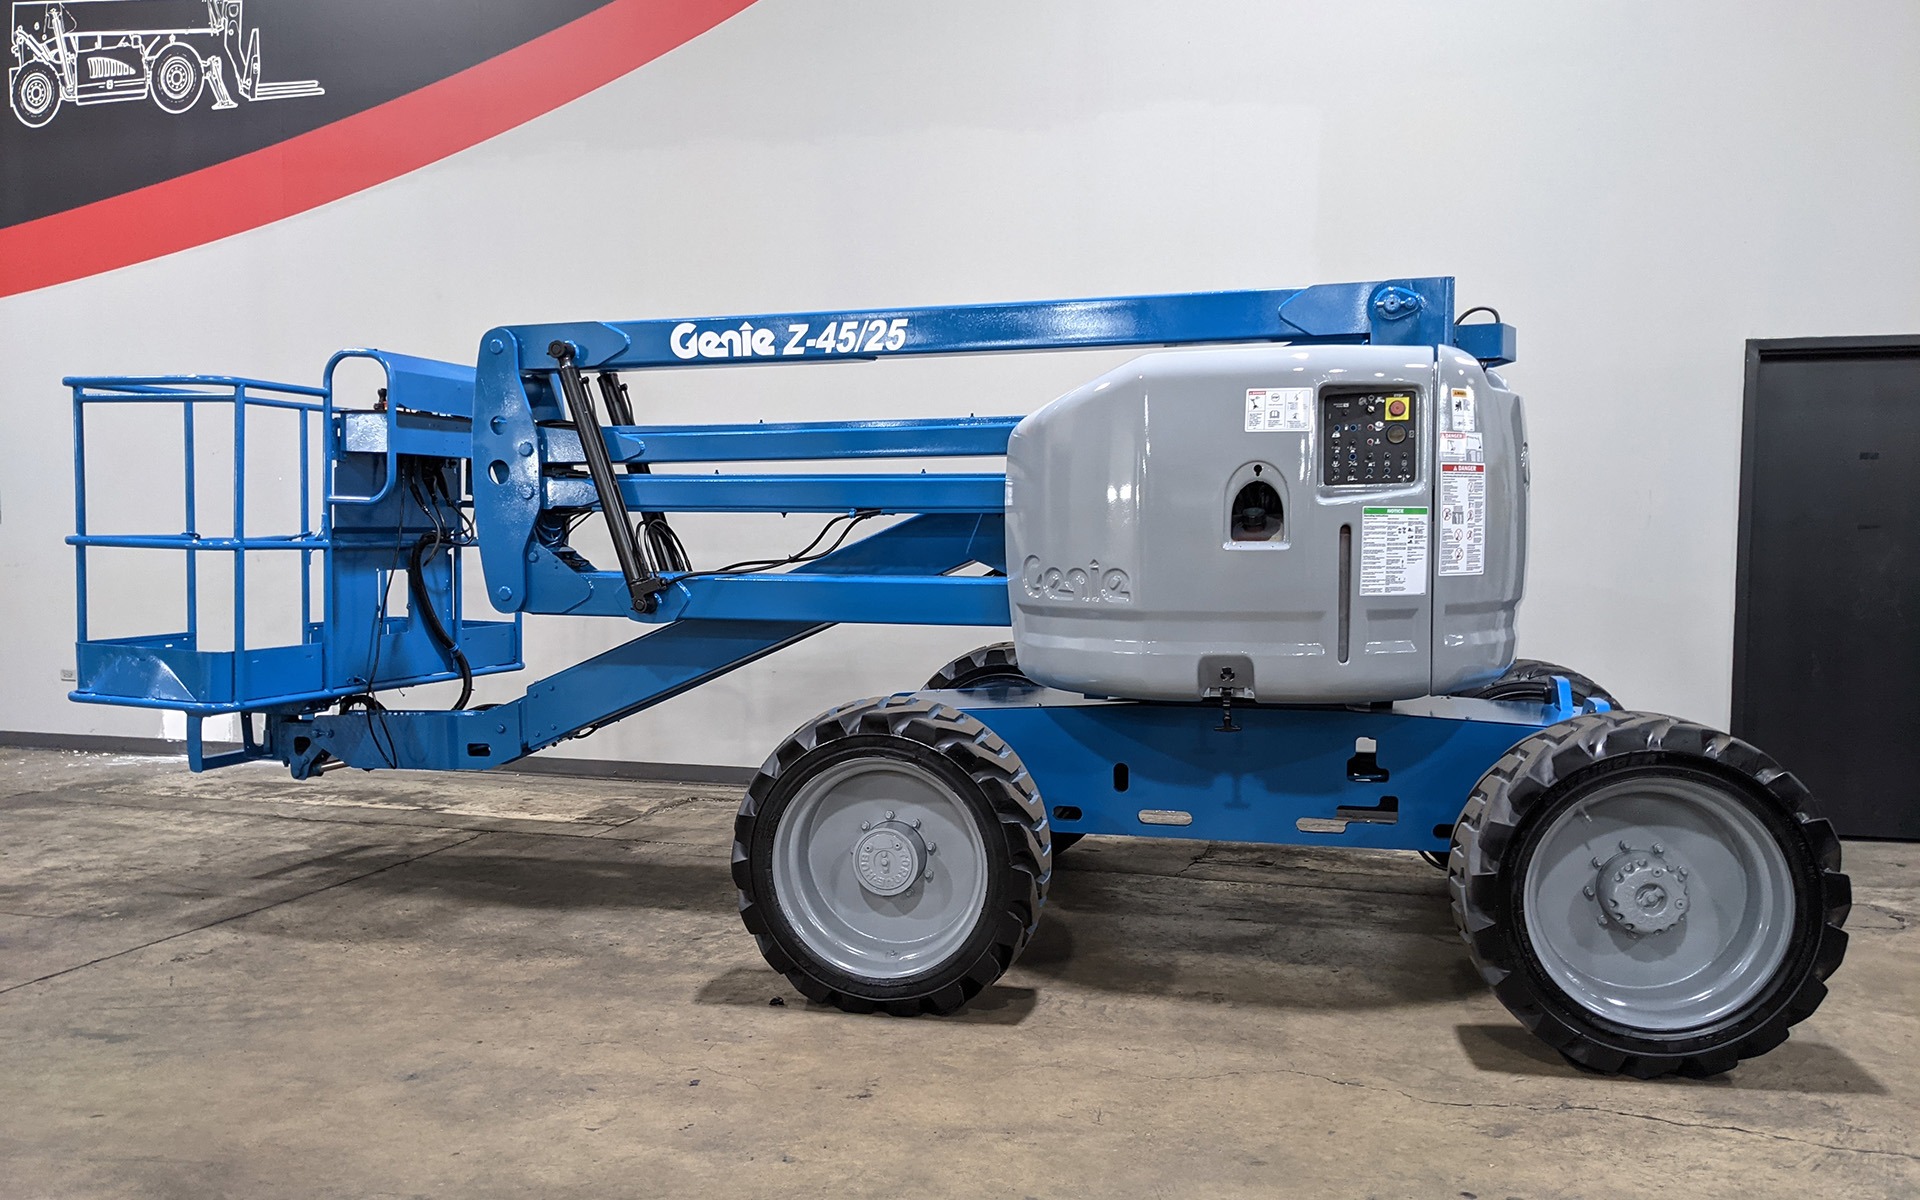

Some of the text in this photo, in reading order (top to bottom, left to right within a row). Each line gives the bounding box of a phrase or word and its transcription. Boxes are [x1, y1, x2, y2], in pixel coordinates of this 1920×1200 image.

[670, 318, 909, 360] Genie Z-45/25
[1022, 554, 1132, 602] Genie
